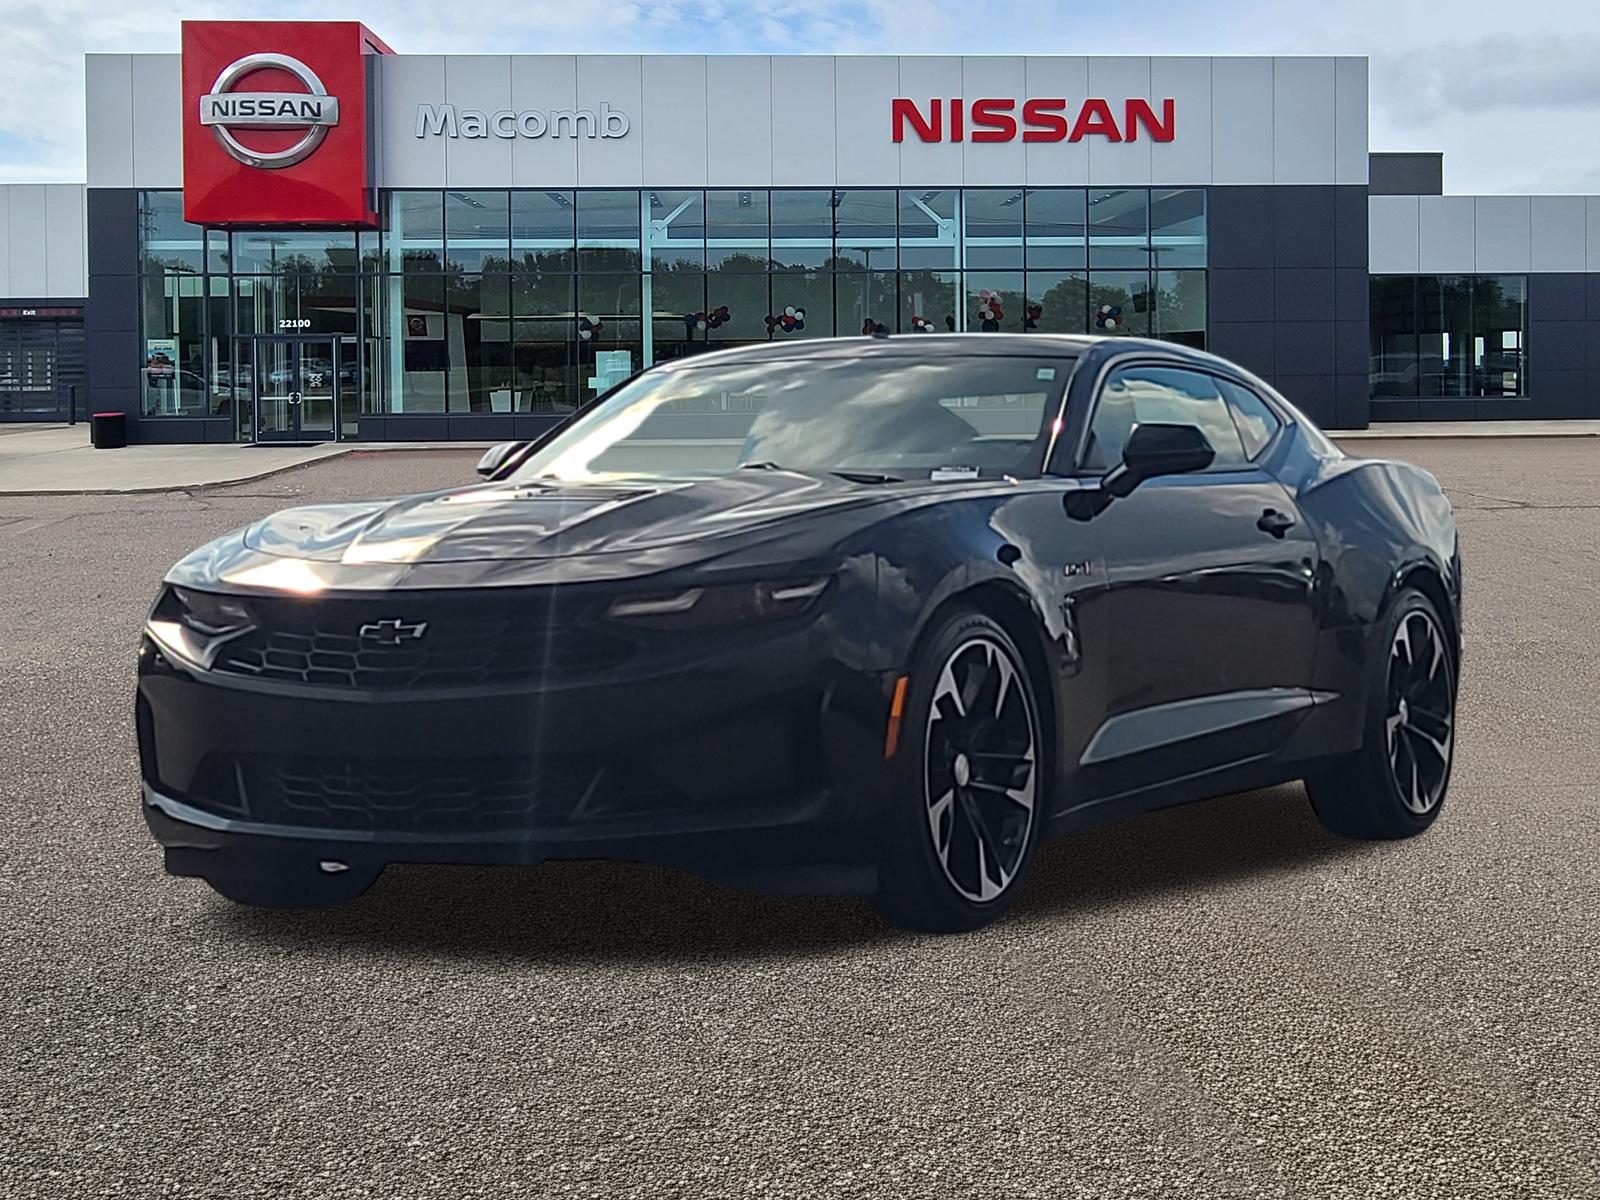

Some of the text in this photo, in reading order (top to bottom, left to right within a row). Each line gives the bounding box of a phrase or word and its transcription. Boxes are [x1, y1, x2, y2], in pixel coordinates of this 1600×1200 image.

[211, 100, 322, 118] NISSAN
[415, 102, 630, 139] Macomb
[891, 98, 1175, 143] NISSAN
[279, 319, 311, 328] 22100
